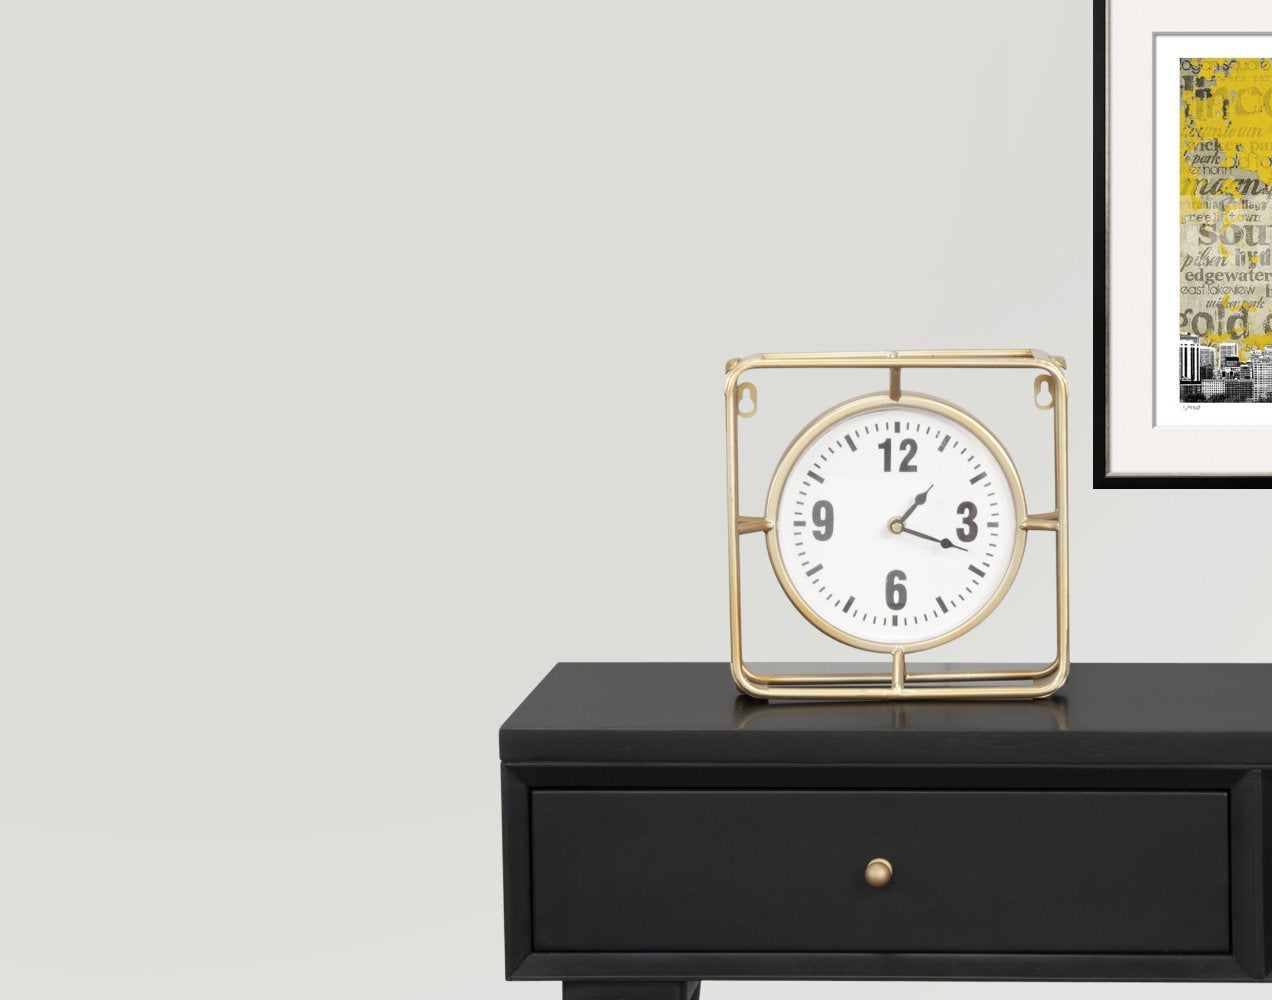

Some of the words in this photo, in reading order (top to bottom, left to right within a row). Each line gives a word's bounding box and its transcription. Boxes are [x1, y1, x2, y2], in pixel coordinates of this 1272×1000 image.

[1180, 246, 1228, 272] pilsen
[1185, 268, 1272, 285] edgewater
[877, 438, 919, 473] 12
[812, 499, 835, 542] 9
[956, 501, 979, 543] 3
[885, 569, 908, 611] 6
